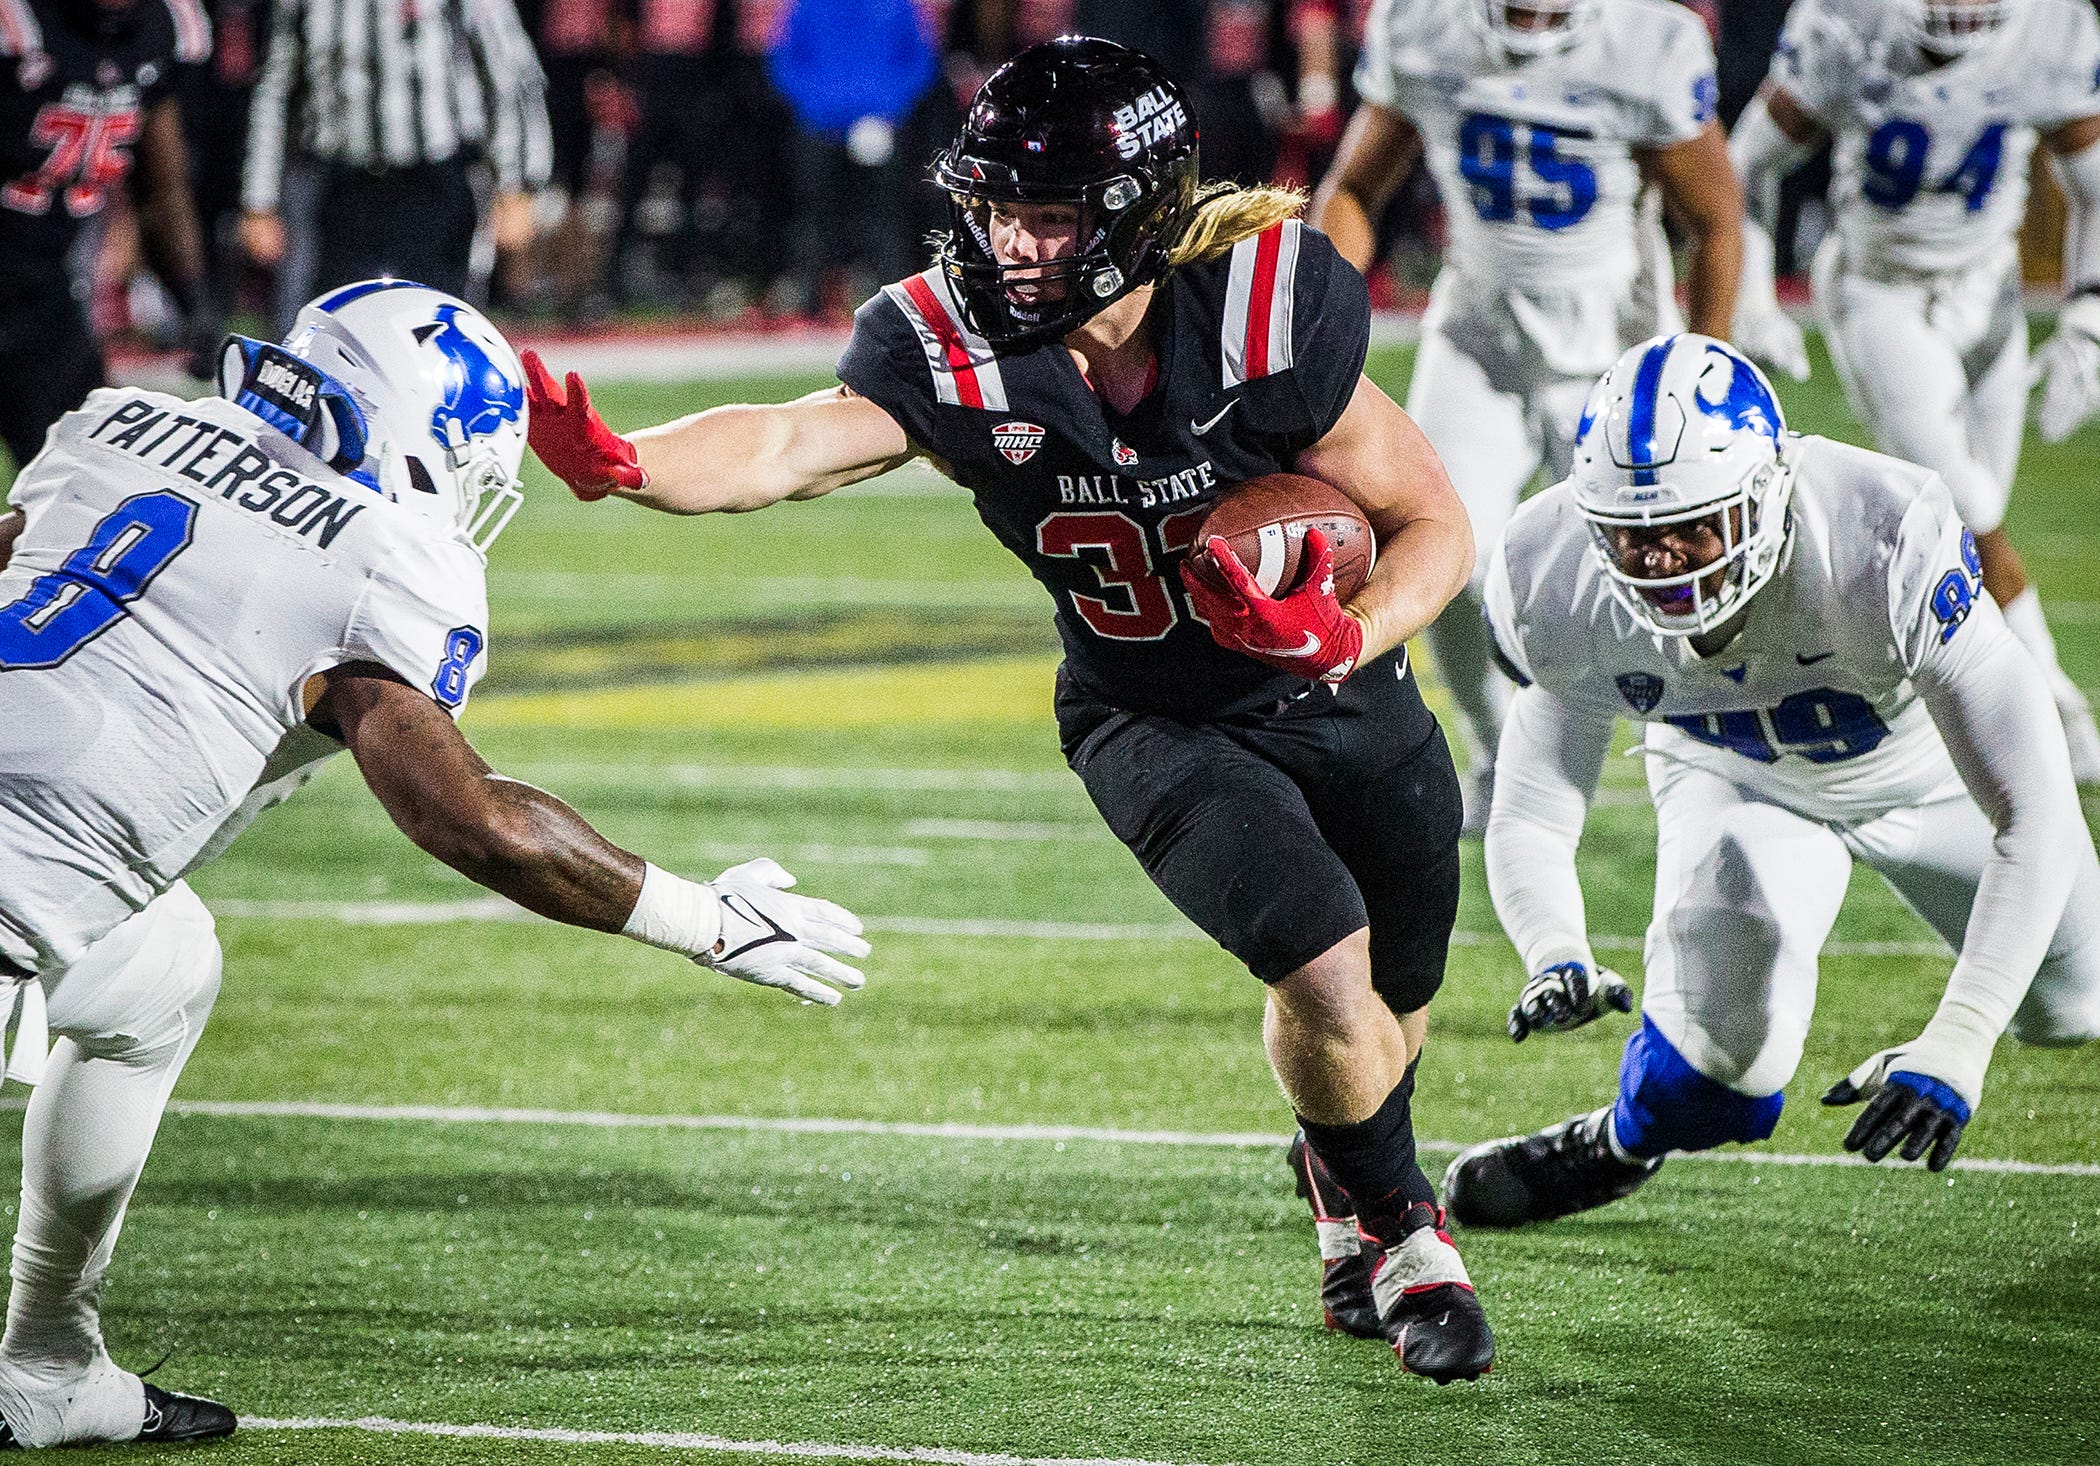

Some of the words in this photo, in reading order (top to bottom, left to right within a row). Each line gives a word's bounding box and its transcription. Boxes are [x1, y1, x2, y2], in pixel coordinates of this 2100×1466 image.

[1113, 85, 1174, 132] BALL
[1116, 101, 1187, 159] STATE
[1460, 110, 1598, 230] 95
[1862, 117, 2007, 212] 94
[1009, 305, 1040, 322] Riddell
[89, 399, 366, 550] PATTERSON
[994, 435, 1043, 448] MAC
[1057, 475, 1128, 504] BALL
[1136, 460, 1216, 508] STATE
[0, 488, 200, 672] 8
[430, 625, 483, 709] 8
